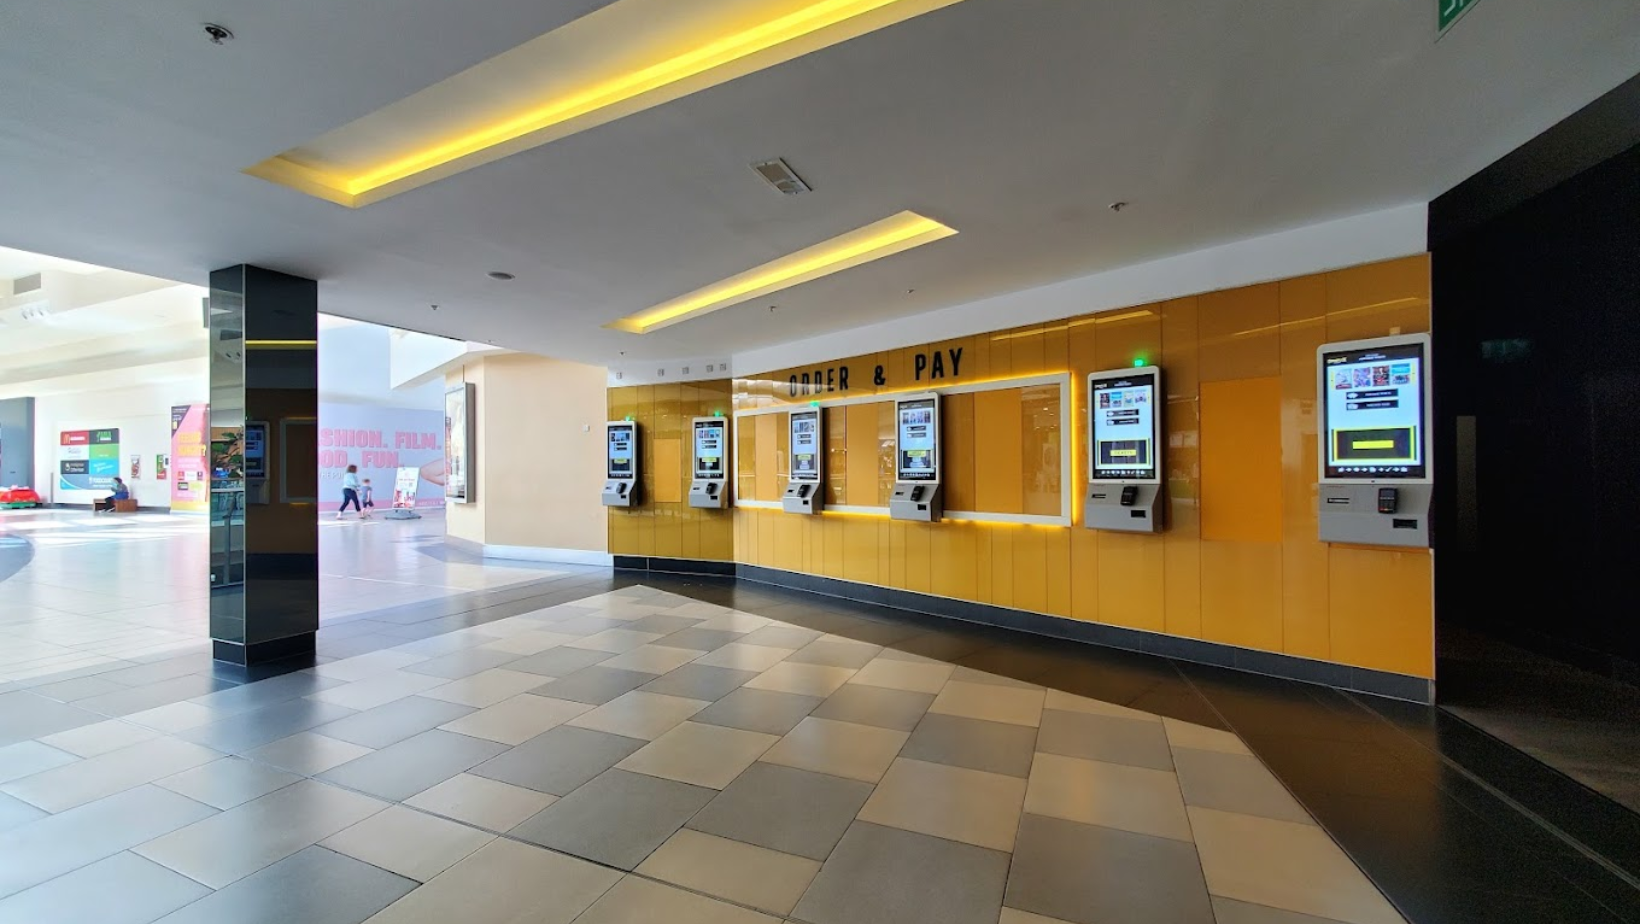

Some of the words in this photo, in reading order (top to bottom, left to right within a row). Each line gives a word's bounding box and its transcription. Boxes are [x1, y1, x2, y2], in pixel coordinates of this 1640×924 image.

[789, 366, 849, 397] ORDER
[873, 364, 886, 386] &
[915, 347, 963, 381] PAY
[318, 428, 388, 448] SHION.
[395, 431, 442, 450] FILM.
[318, 449, 348, 468] OD
